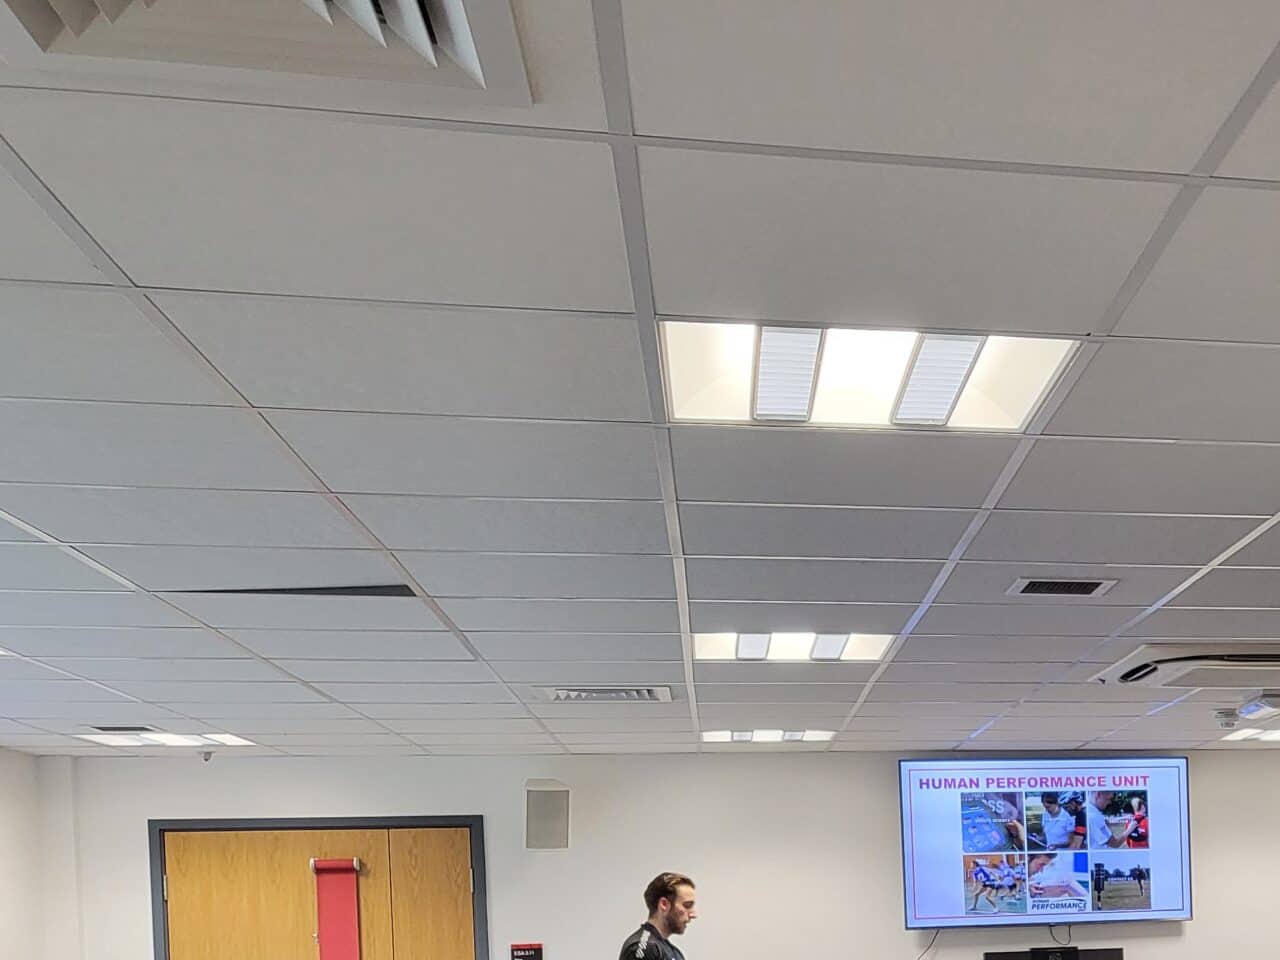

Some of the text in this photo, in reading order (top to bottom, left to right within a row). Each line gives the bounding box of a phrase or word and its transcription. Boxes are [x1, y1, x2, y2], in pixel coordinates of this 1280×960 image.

[919, 774, 1150, 790] HUMAN PERFORMANCE UNIT
[1031, 902, 1087, 910] PERFORMANCE
